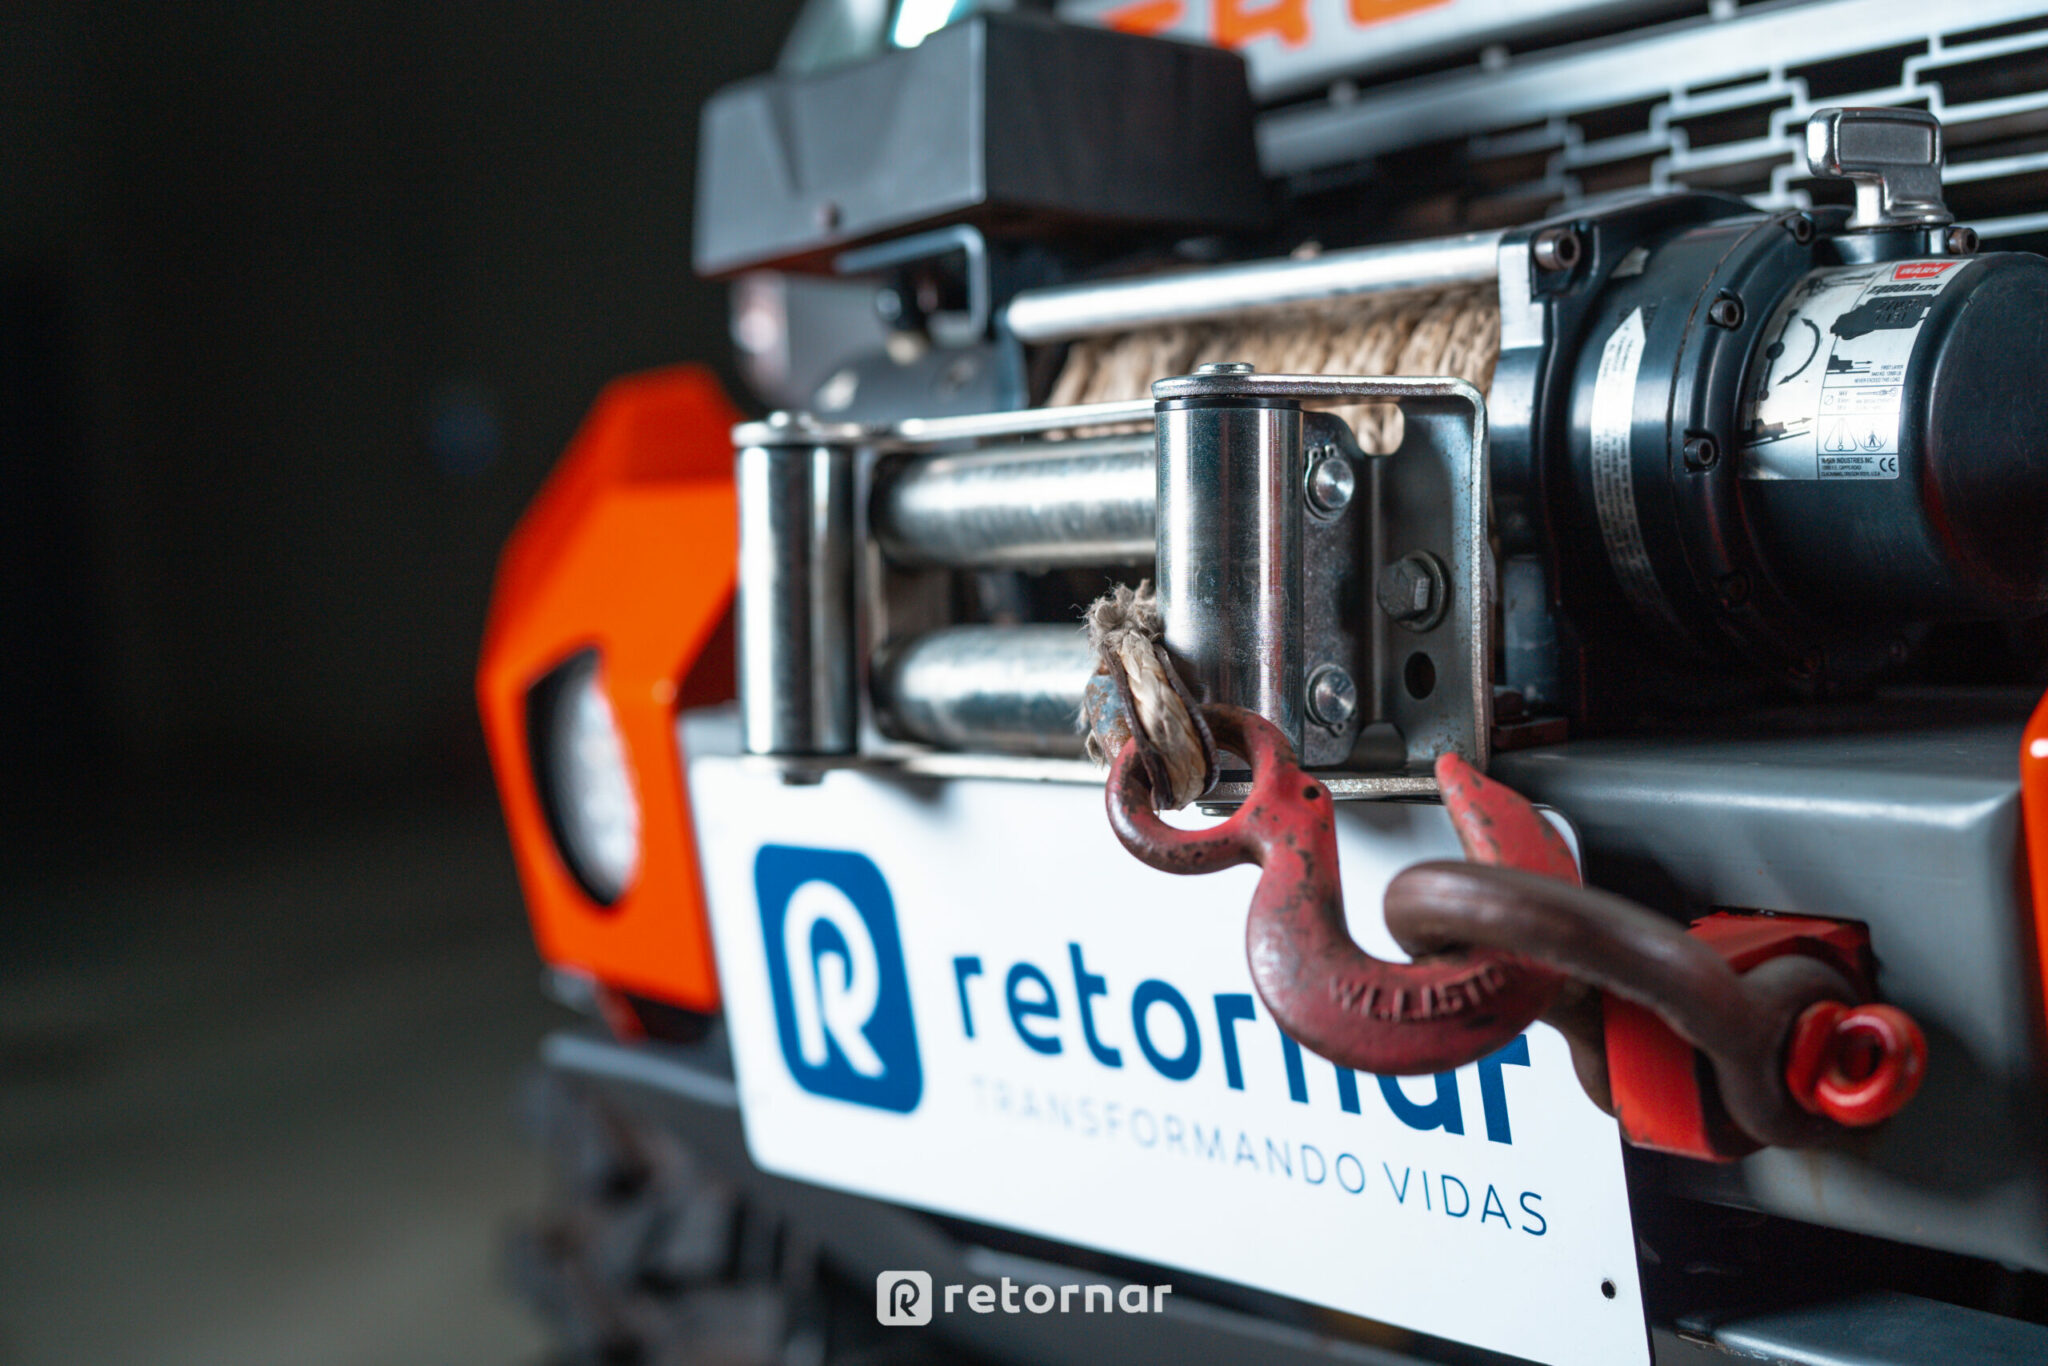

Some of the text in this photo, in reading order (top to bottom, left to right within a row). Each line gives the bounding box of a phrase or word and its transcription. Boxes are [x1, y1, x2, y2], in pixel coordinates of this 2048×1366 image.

[1899, 266, 1943, 275] WARN
[1879, 457, 1896, 472] CE
[968, 1073, 1549, 1238] TRANSFORMANDO VIDAS
